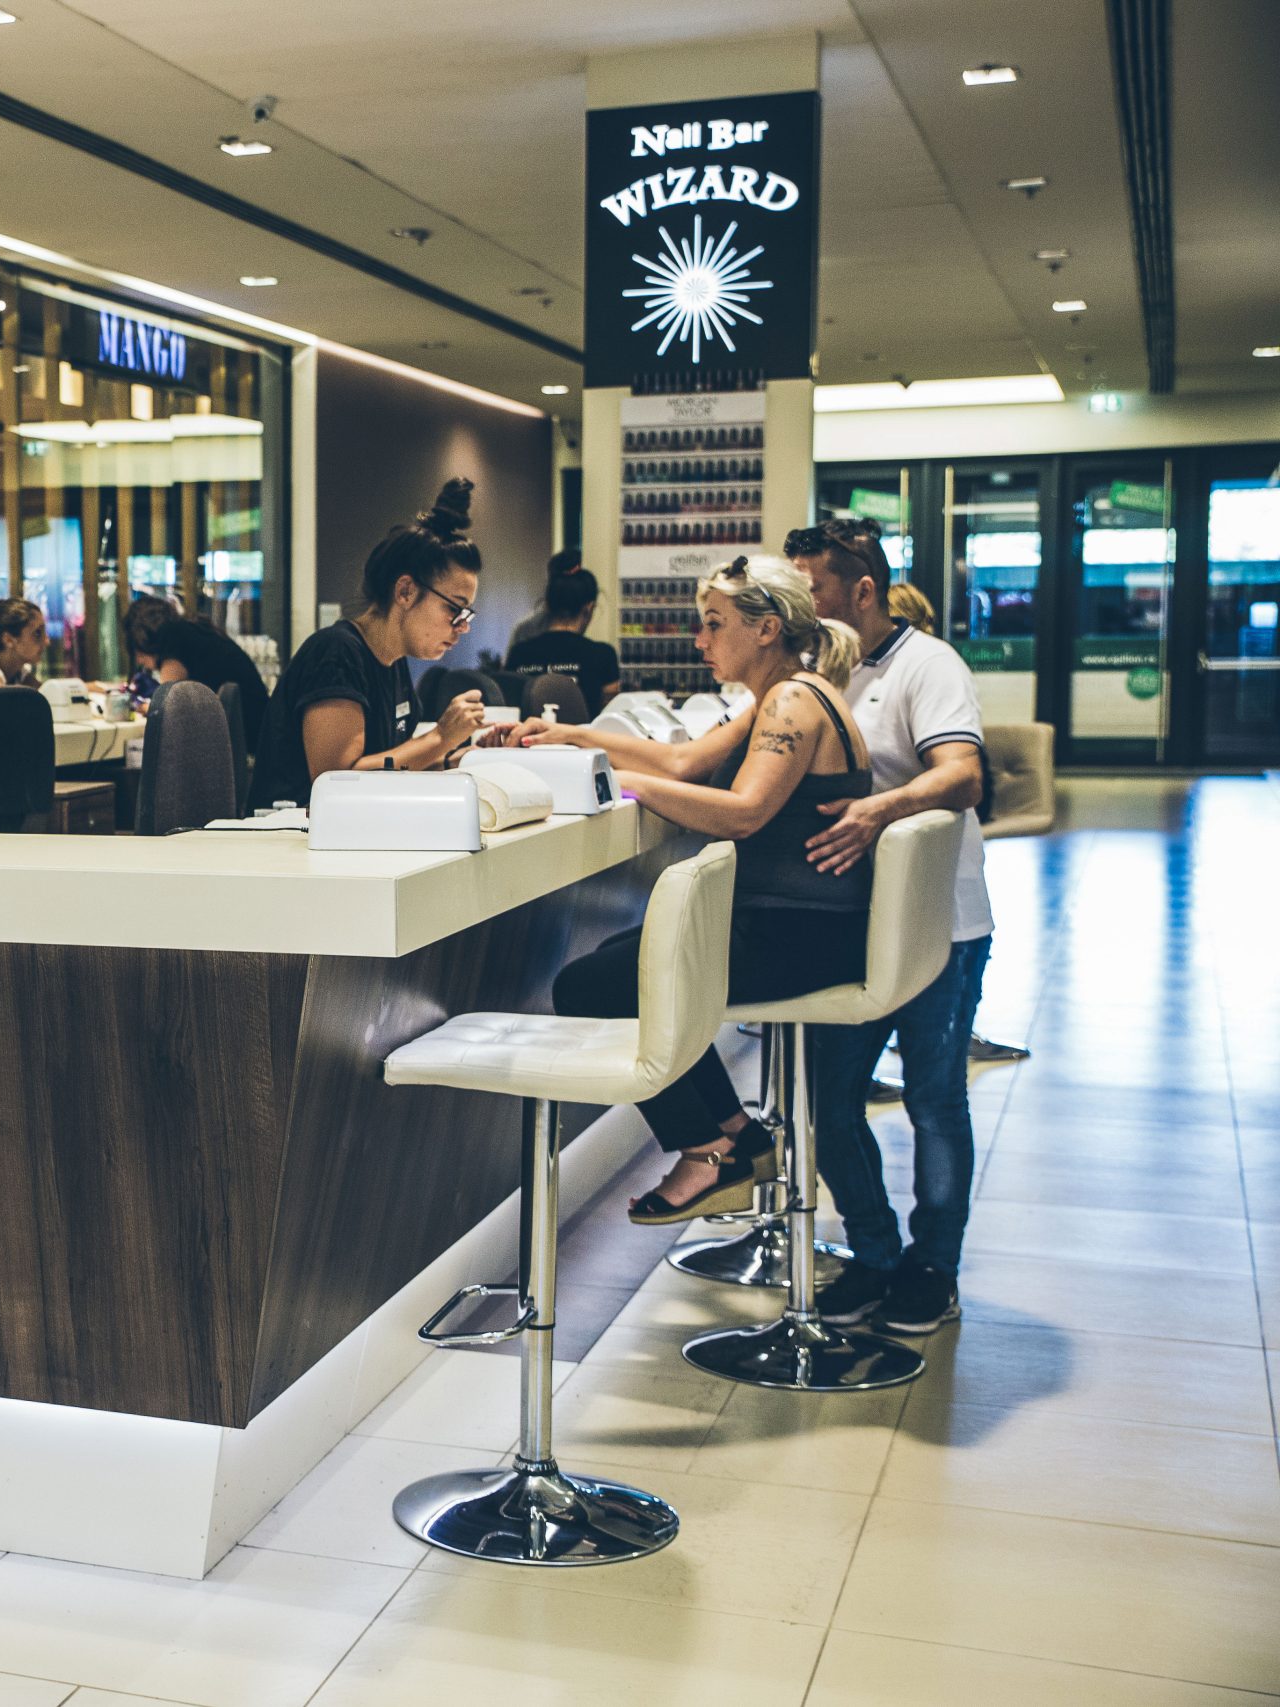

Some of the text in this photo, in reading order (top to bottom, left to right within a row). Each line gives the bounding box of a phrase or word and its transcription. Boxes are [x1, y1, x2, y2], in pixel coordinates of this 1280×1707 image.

[631, 119, 769, 157] Nail Bar
[600, 165, 799, 227] WIZARD
[98, 309, 187, 382] MANGO
